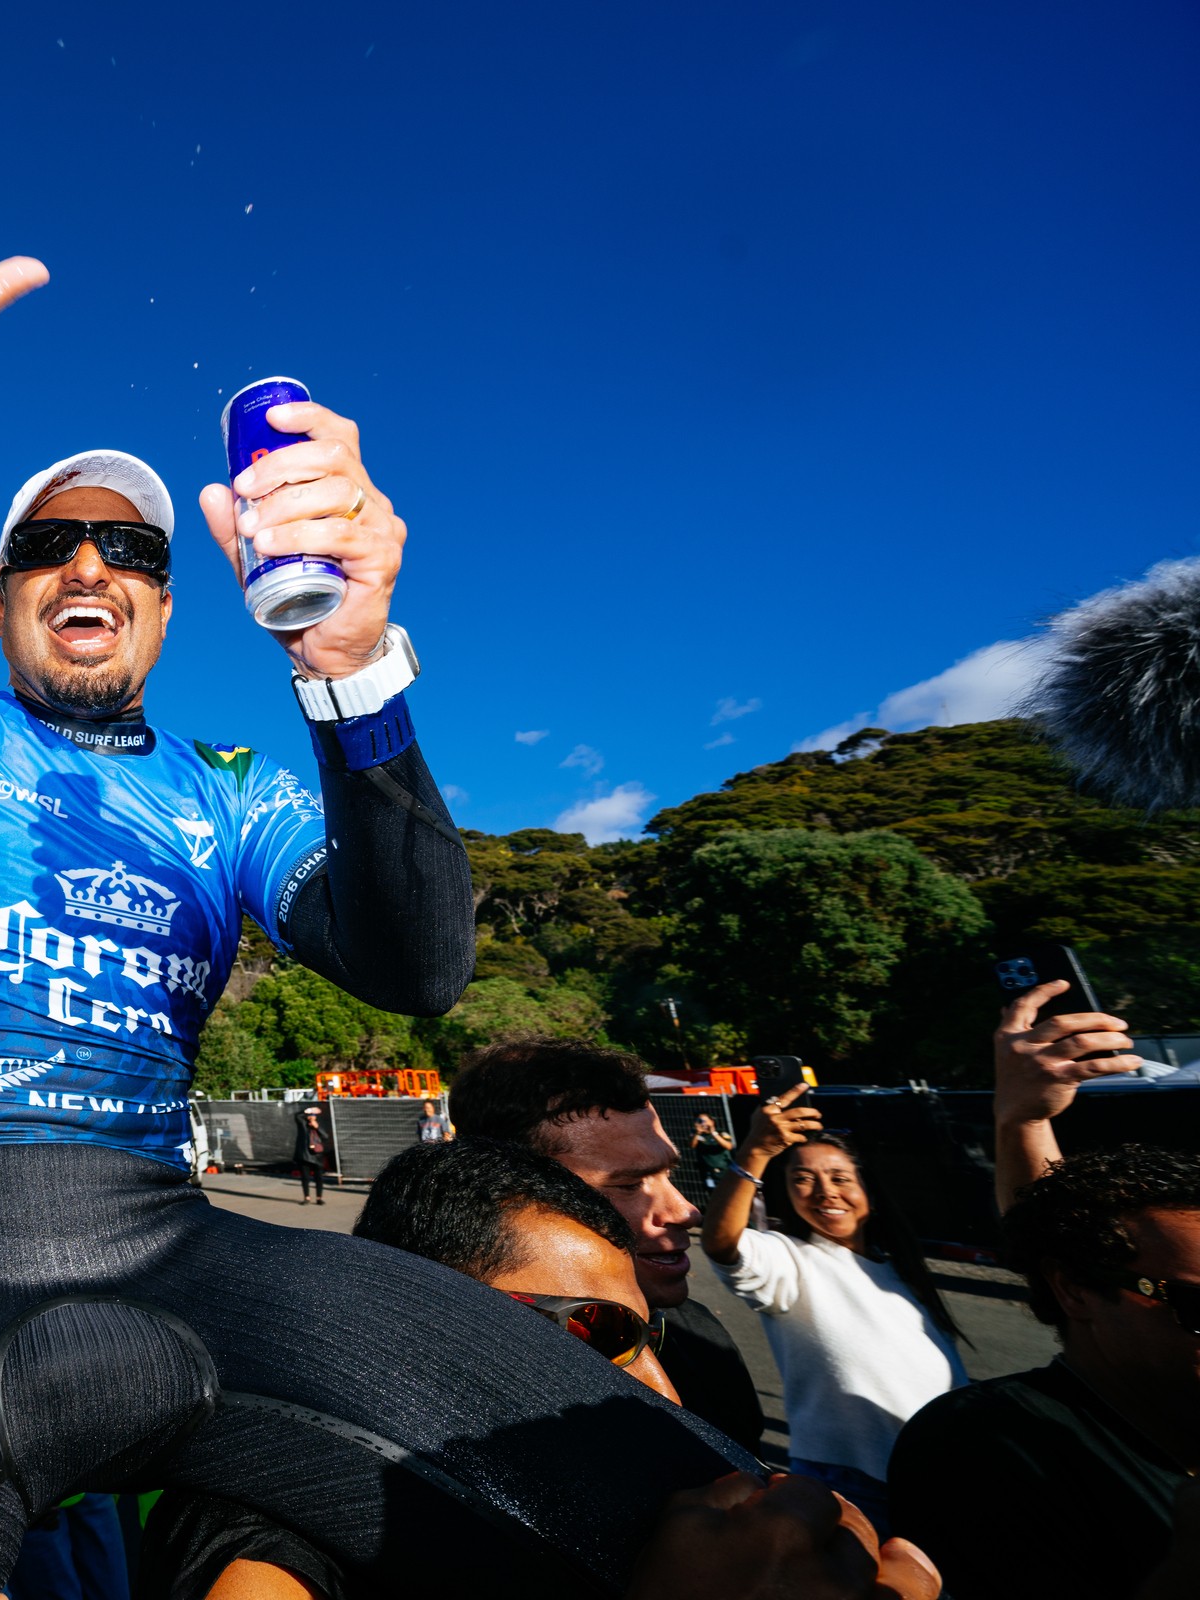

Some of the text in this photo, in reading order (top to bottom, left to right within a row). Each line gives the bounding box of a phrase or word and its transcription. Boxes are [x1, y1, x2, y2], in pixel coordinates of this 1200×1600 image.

[75, 731, 112, 746] SURF
[15, 786, 68, 819] WSL
[278, 882, 298, 924] 2026
